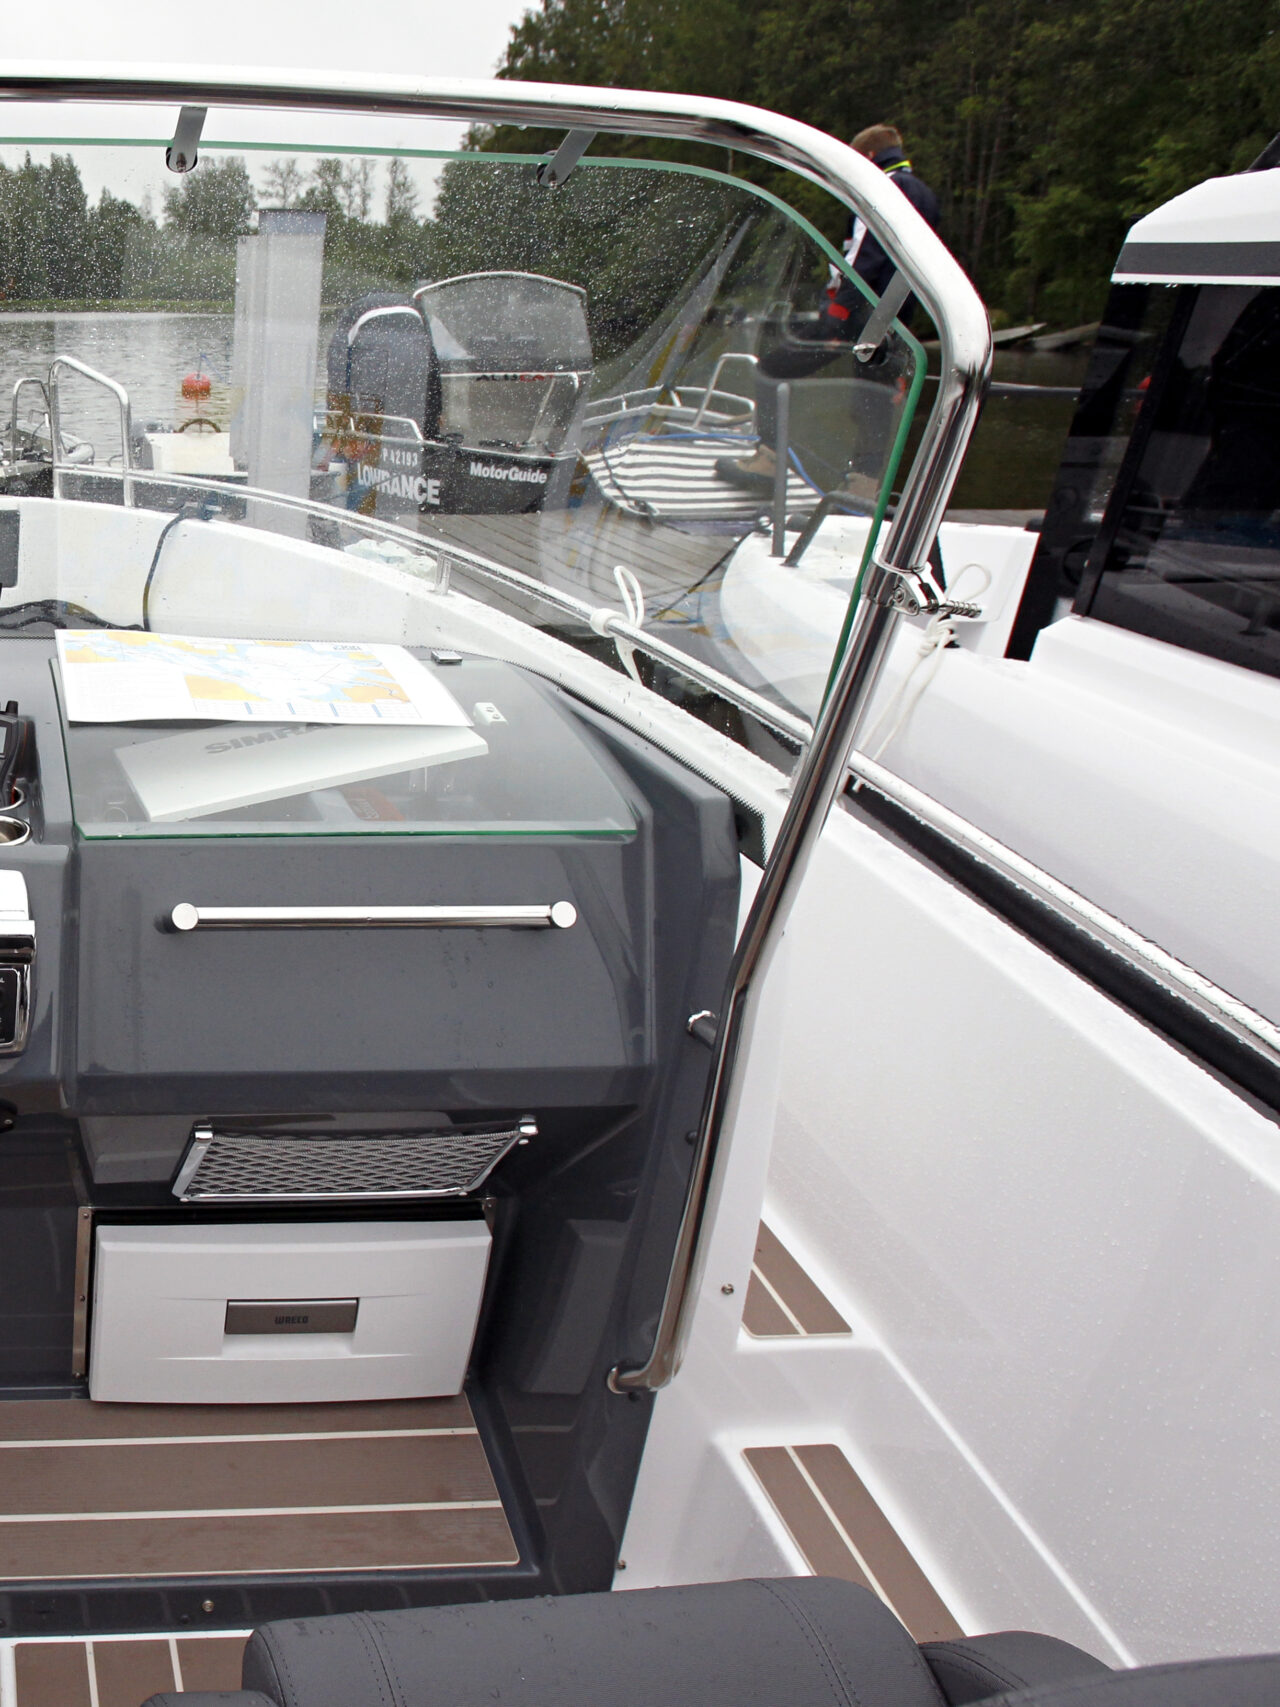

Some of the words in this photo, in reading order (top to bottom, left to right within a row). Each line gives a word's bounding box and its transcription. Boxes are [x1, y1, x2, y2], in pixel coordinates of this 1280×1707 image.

[357, 462, 440, 505] LOWRANCE
[470, 461, 548, 484] MotorGuide
[204, 724, 334, 754] SIMRA
